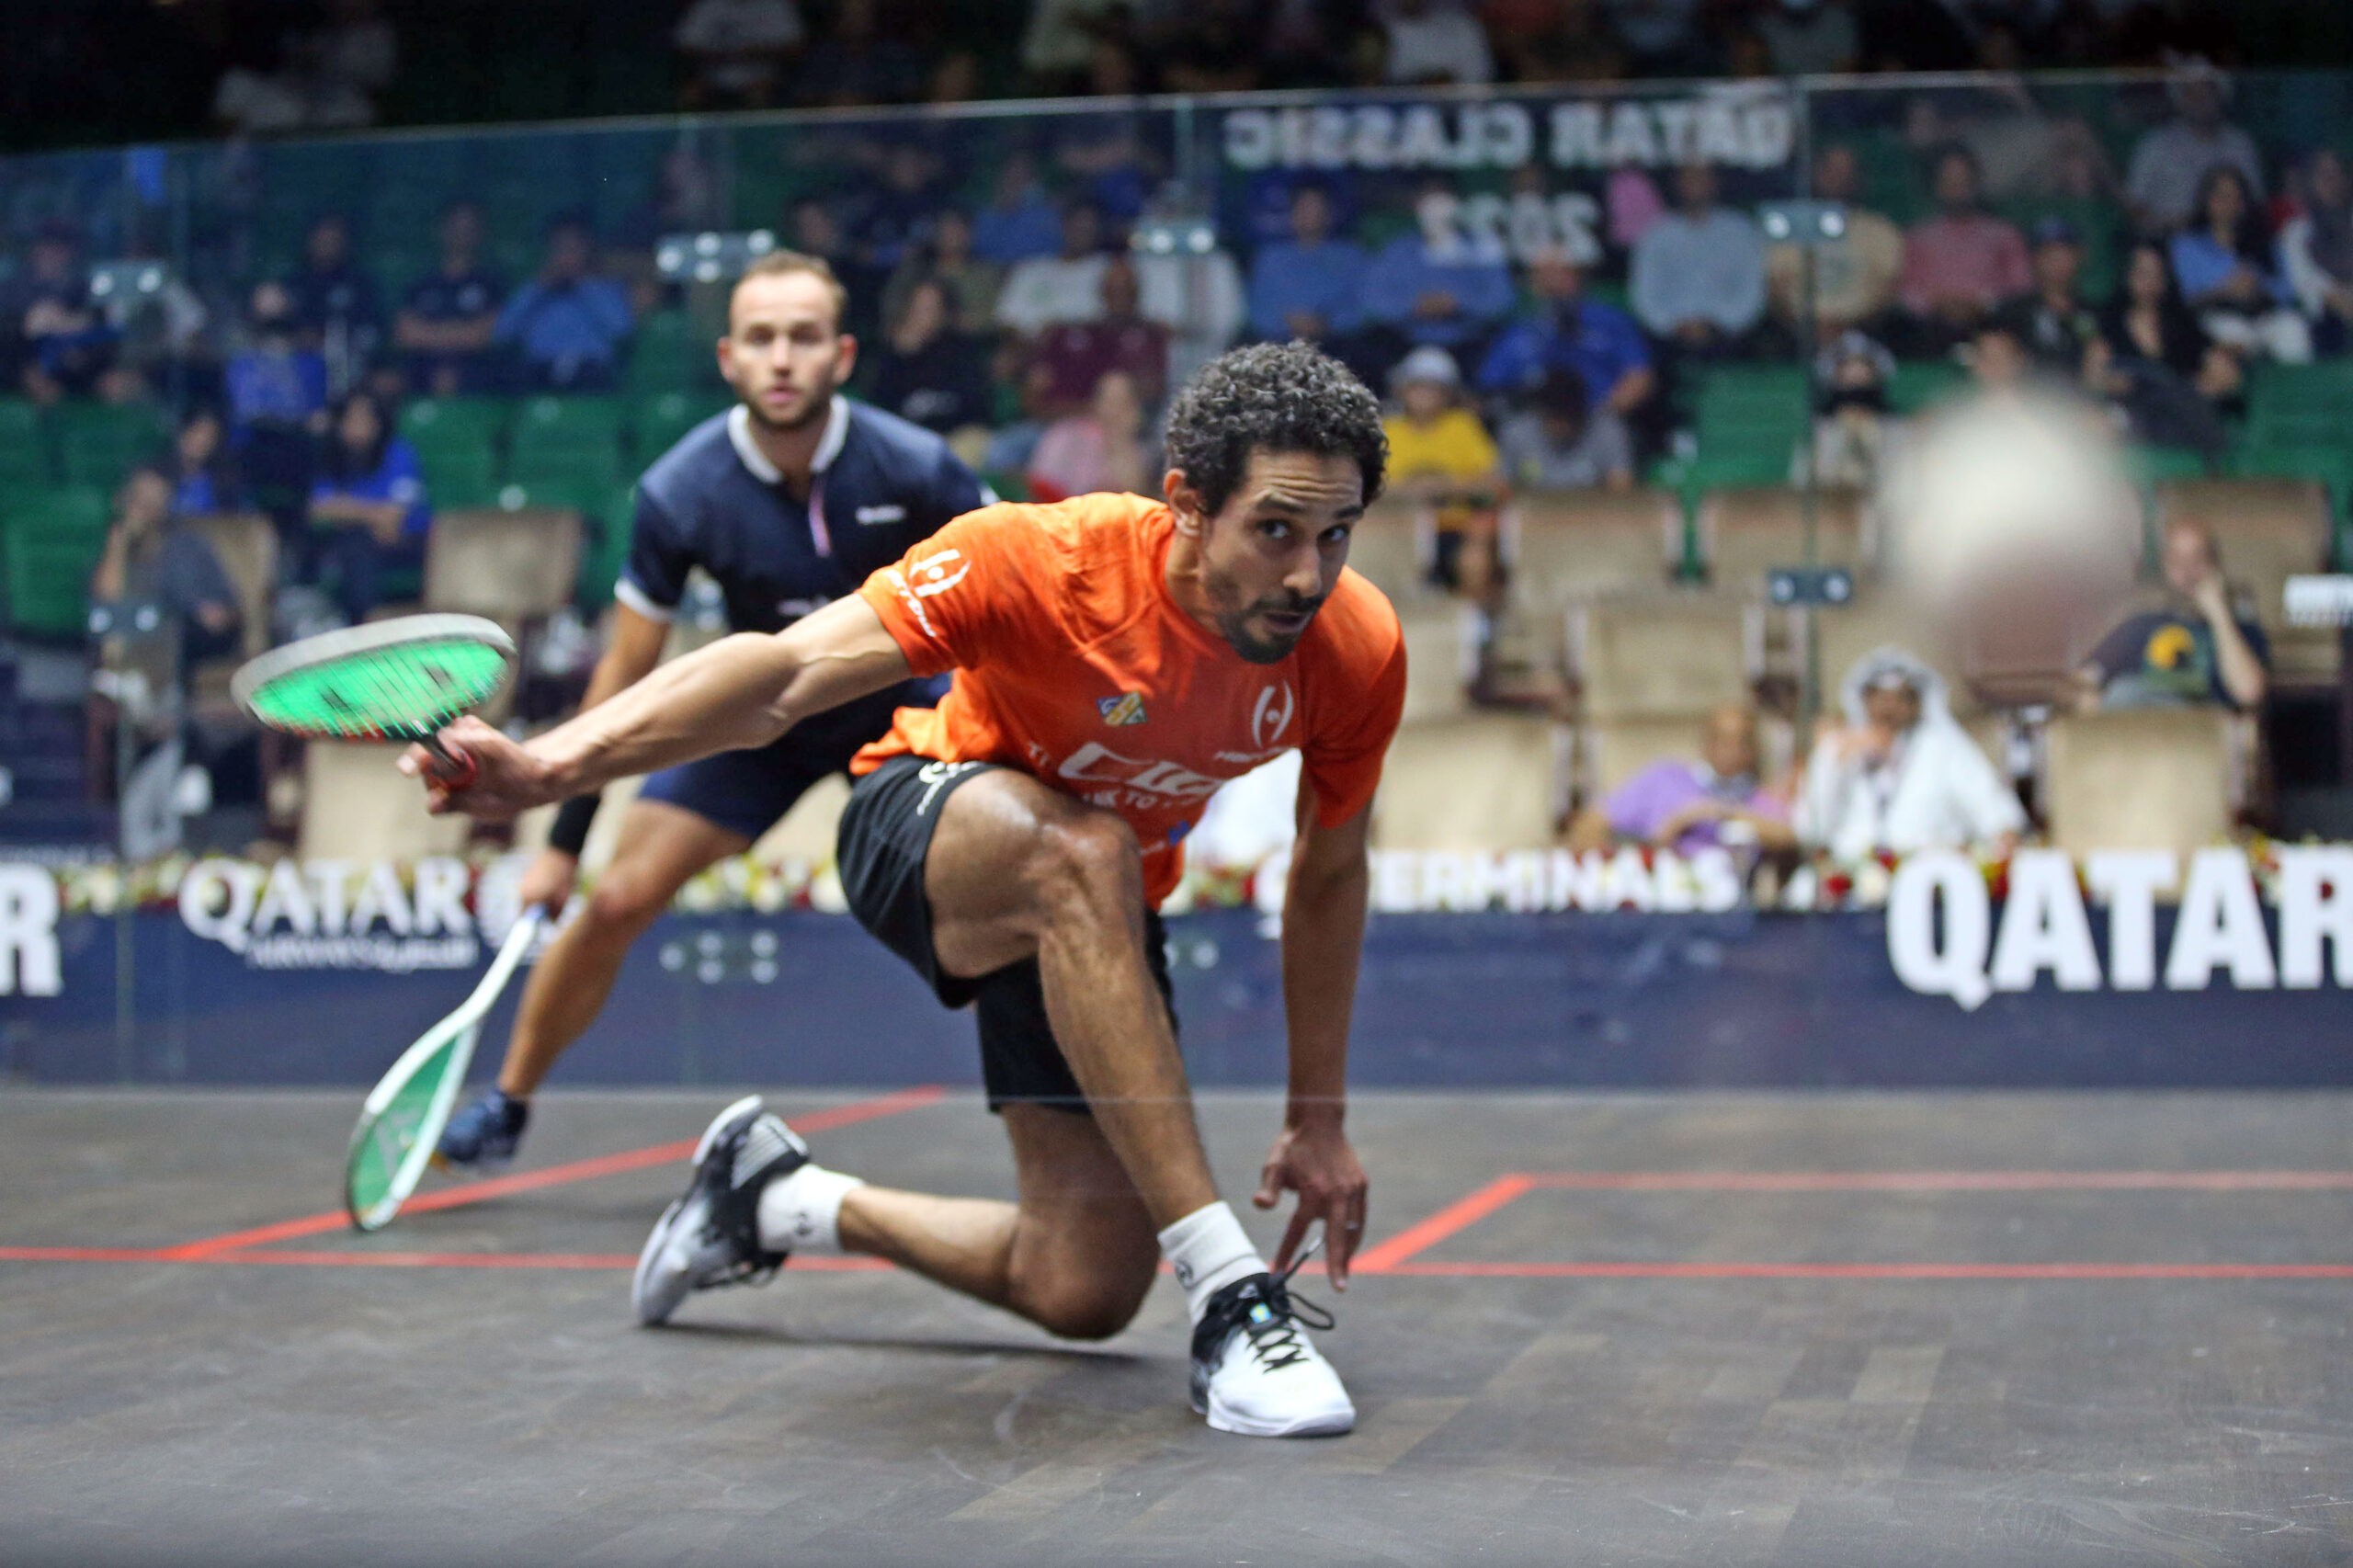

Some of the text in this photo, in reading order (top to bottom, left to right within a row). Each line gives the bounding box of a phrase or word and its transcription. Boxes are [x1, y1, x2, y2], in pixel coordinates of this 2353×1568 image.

[178, 856, 476, 953] QATAR
[1367, 846, 1740, 914] ERMINALS
[1886, 846, 2353, 1012] QATAR
